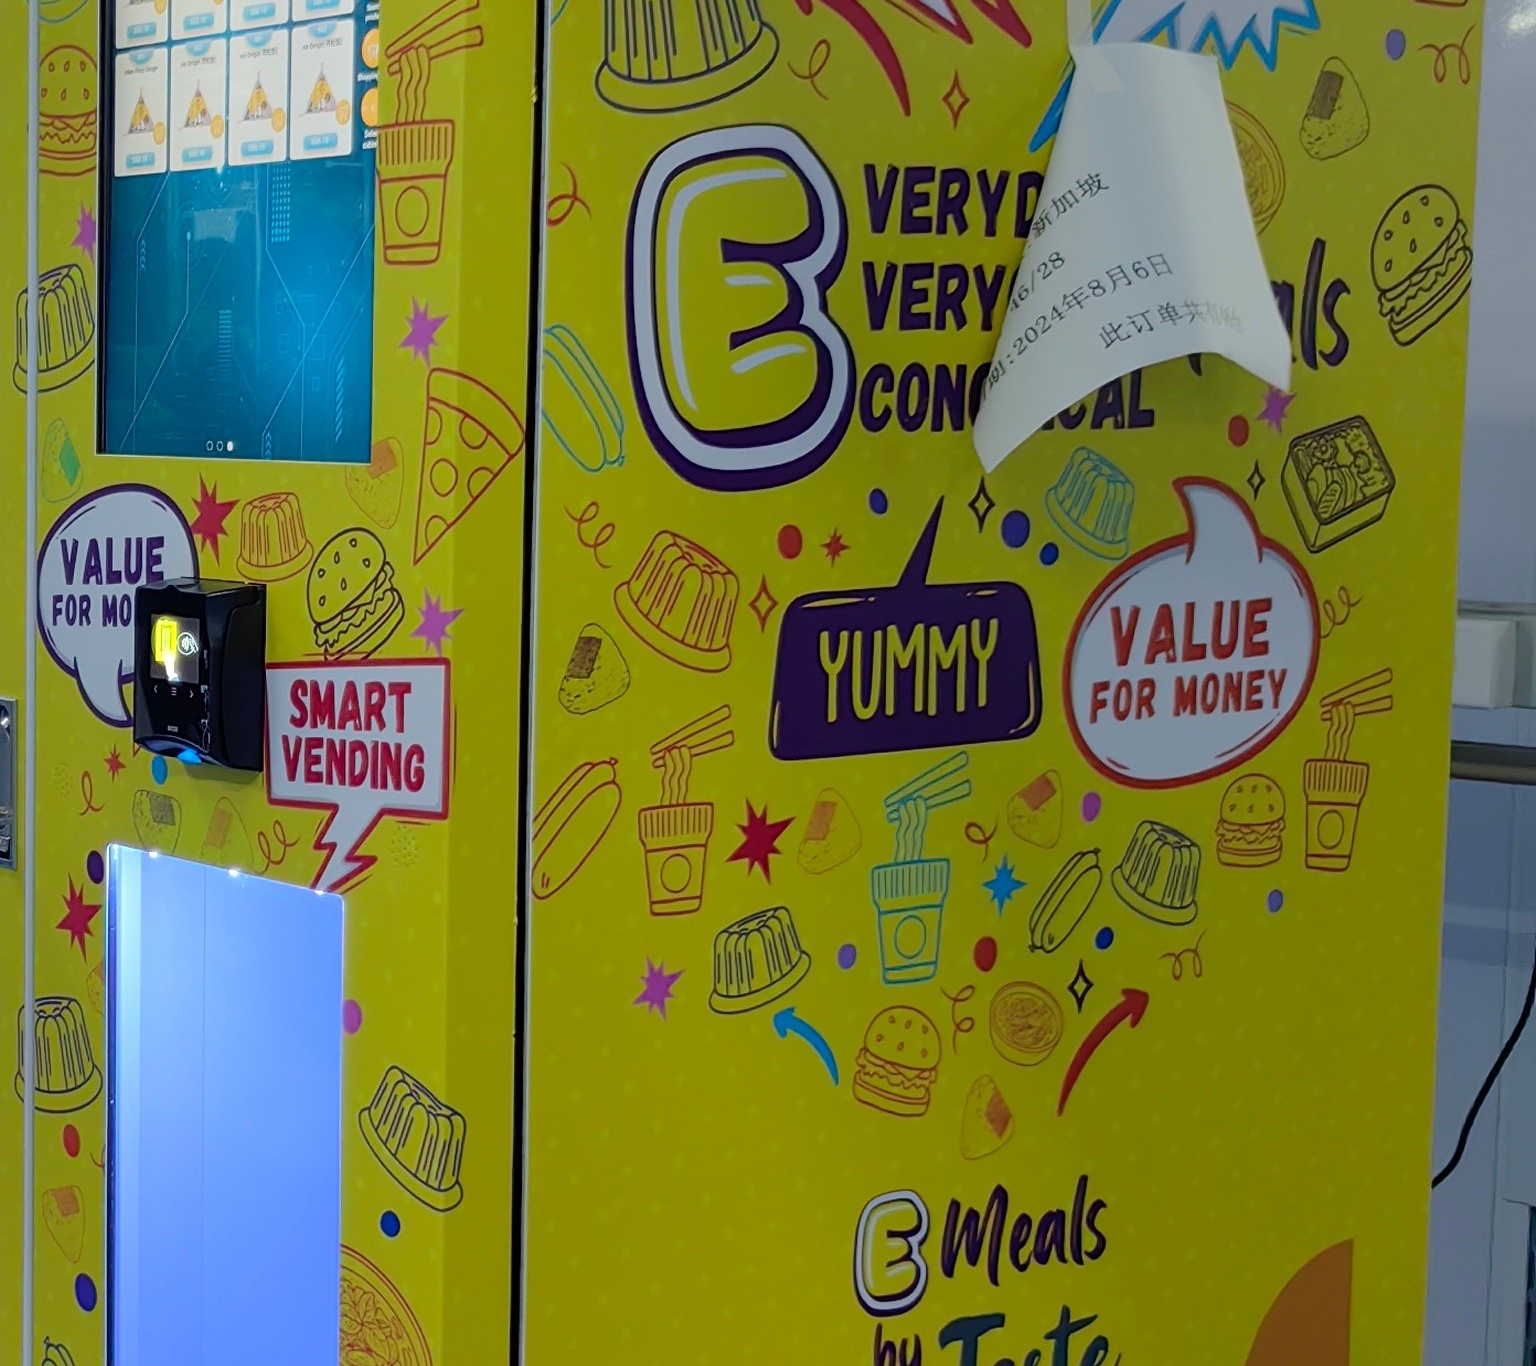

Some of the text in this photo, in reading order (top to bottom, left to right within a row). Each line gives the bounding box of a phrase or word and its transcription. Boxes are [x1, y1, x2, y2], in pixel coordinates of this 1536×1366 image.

[864, 162, 1041, 240] VERYD
[864, 263, 1017, 331] VERY
[60, 536, 166, 586] VALUE
[52, 594, 137, 628] FOR MO
[1111, 595, 1272, 667] VALUE
[818, 618, 999, 725] YUMMY
[1090, 666, 1288, 725] FOR MONEY
[289, 679, 412, 734] SMART
[281, 735, 425, 793] VENDING
[941, 1173, 1109, 1287] Meals
